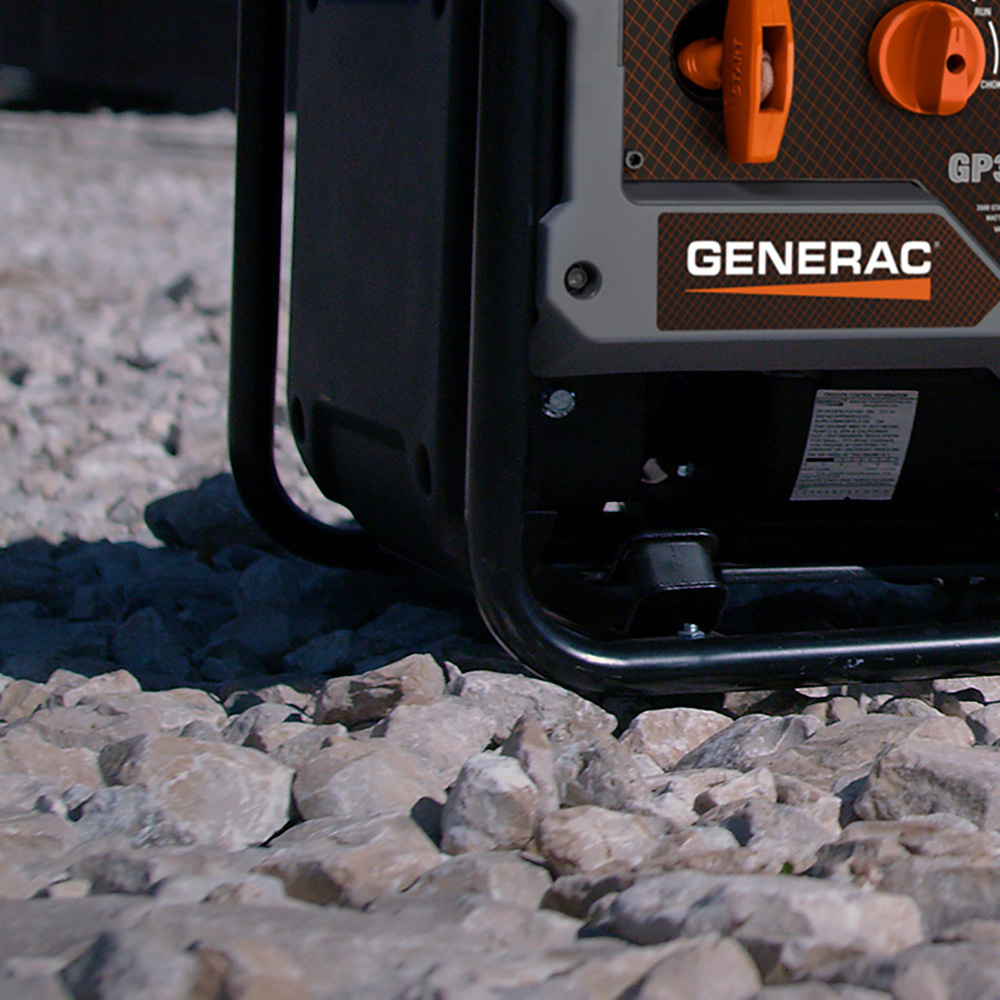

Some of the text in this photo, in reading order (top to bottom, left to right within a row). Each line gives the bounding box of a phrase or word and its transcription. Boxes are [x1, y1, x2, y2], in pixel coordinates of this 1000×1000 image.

[974, 7, 992, 17] RUN
[731, 37, 745, 97] START
[686, 240, 932, 276] GENERAC
